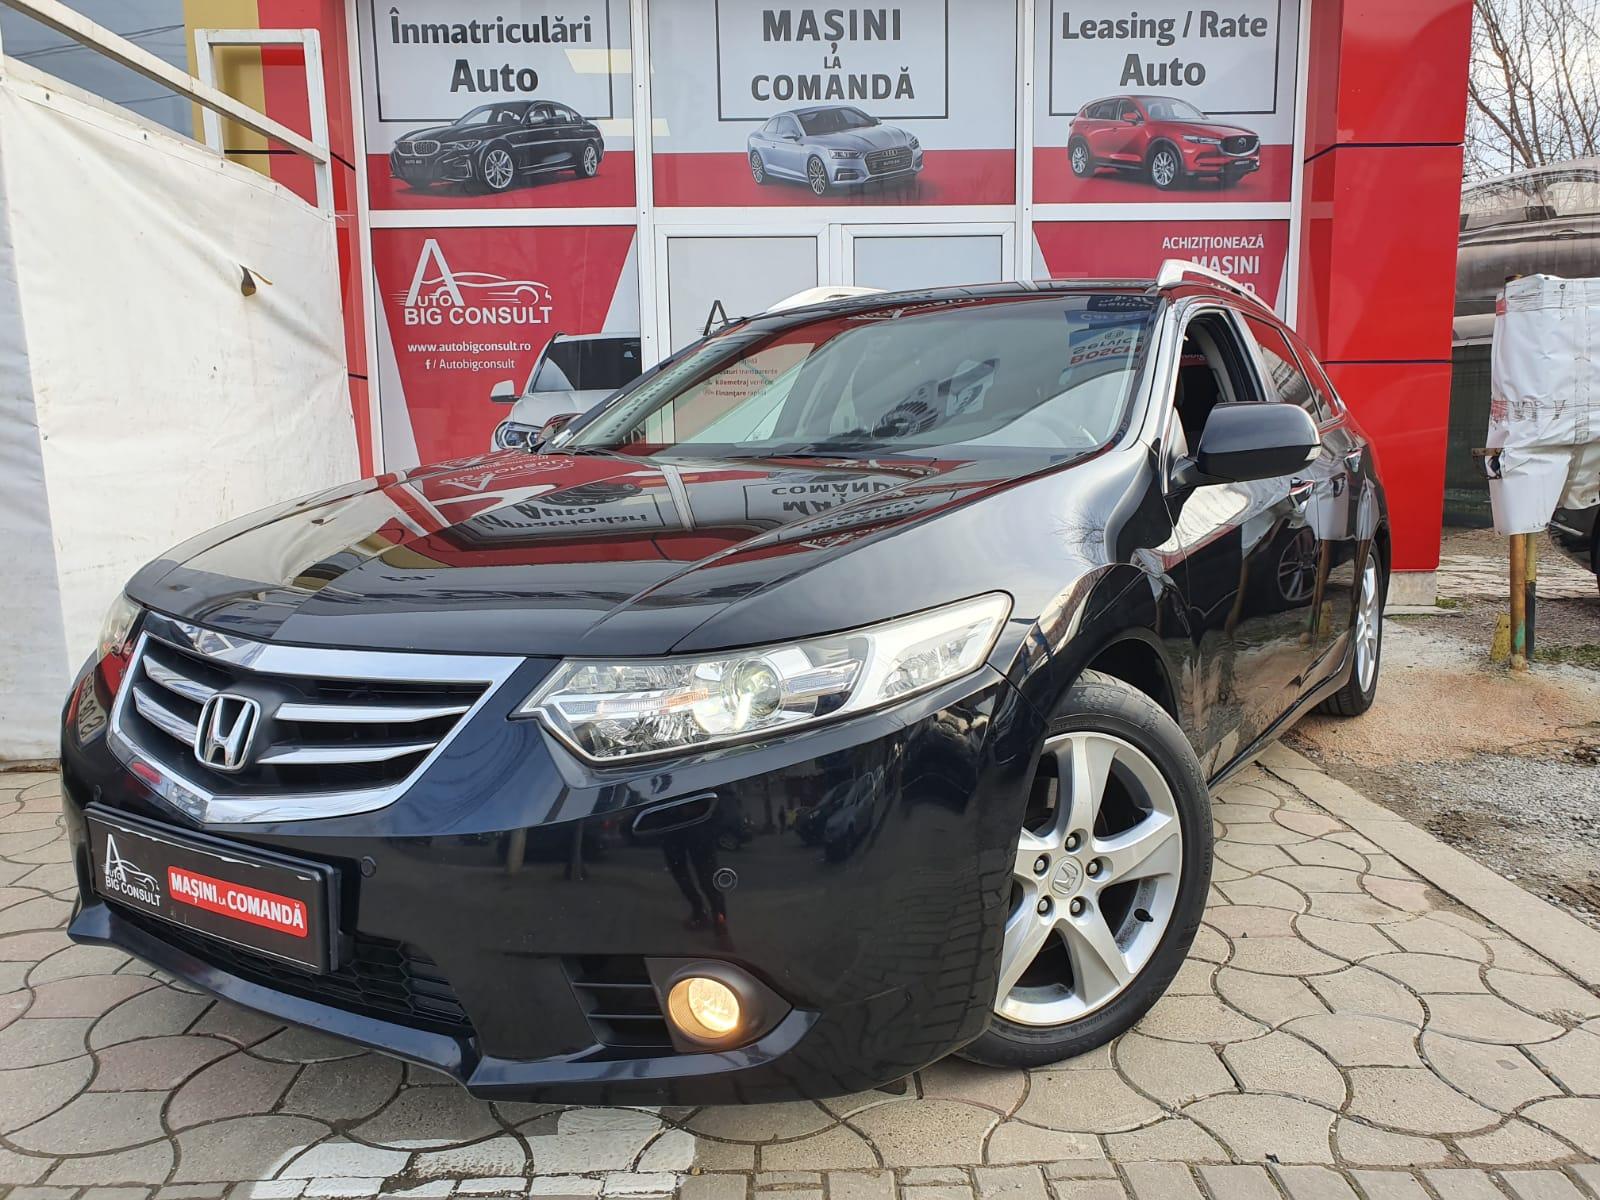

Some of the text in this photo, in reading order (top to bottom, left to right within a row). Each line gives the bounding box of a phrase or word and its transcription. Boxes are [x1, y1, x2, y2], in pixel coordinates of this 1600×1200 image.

[389, 7, 592, 45] Înmatriculări
[763, 9, 902, 54] MAȘINI
[1061, 12, 1175, 47] Leasing
[1200, 10, 1268, 38] Rate
[450, 58, 539, 93] Auto
[823, 55, 842, 69] LA
[1120, 53, 1206, 87] Auto
[751, 67, 916, 101] COMANDĂ
[404, 306, 552, 325] BIG CONSULT
[407, 341, 531, 354] www.autobigconsult.ro
[439, 358, 515, 371] Autobigconsult
[105, 875, 161, 907] BIG CONSULT
[170, 872, 218, 904] MAȘINI
[227, 890, 304, 929] COMANDĂ
